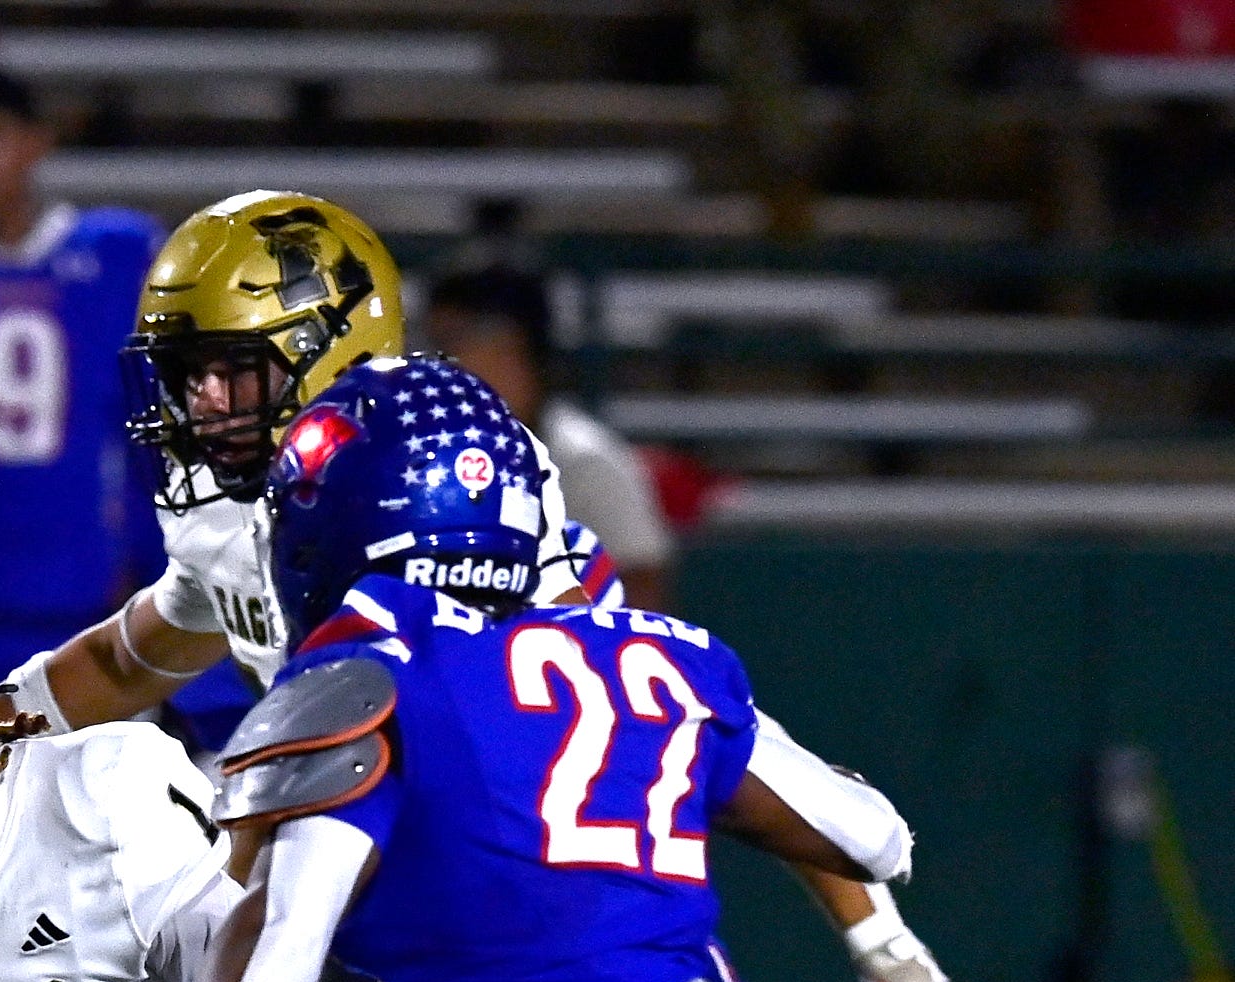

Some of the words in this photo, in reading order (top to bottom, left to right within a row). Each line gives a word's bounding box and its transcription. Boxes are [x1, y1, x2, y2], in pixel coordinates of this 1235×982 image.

[461, 455, 489, 482] 22
[404, 557, 530, 593] Riddell
[505, 622, 715, 888] 22
